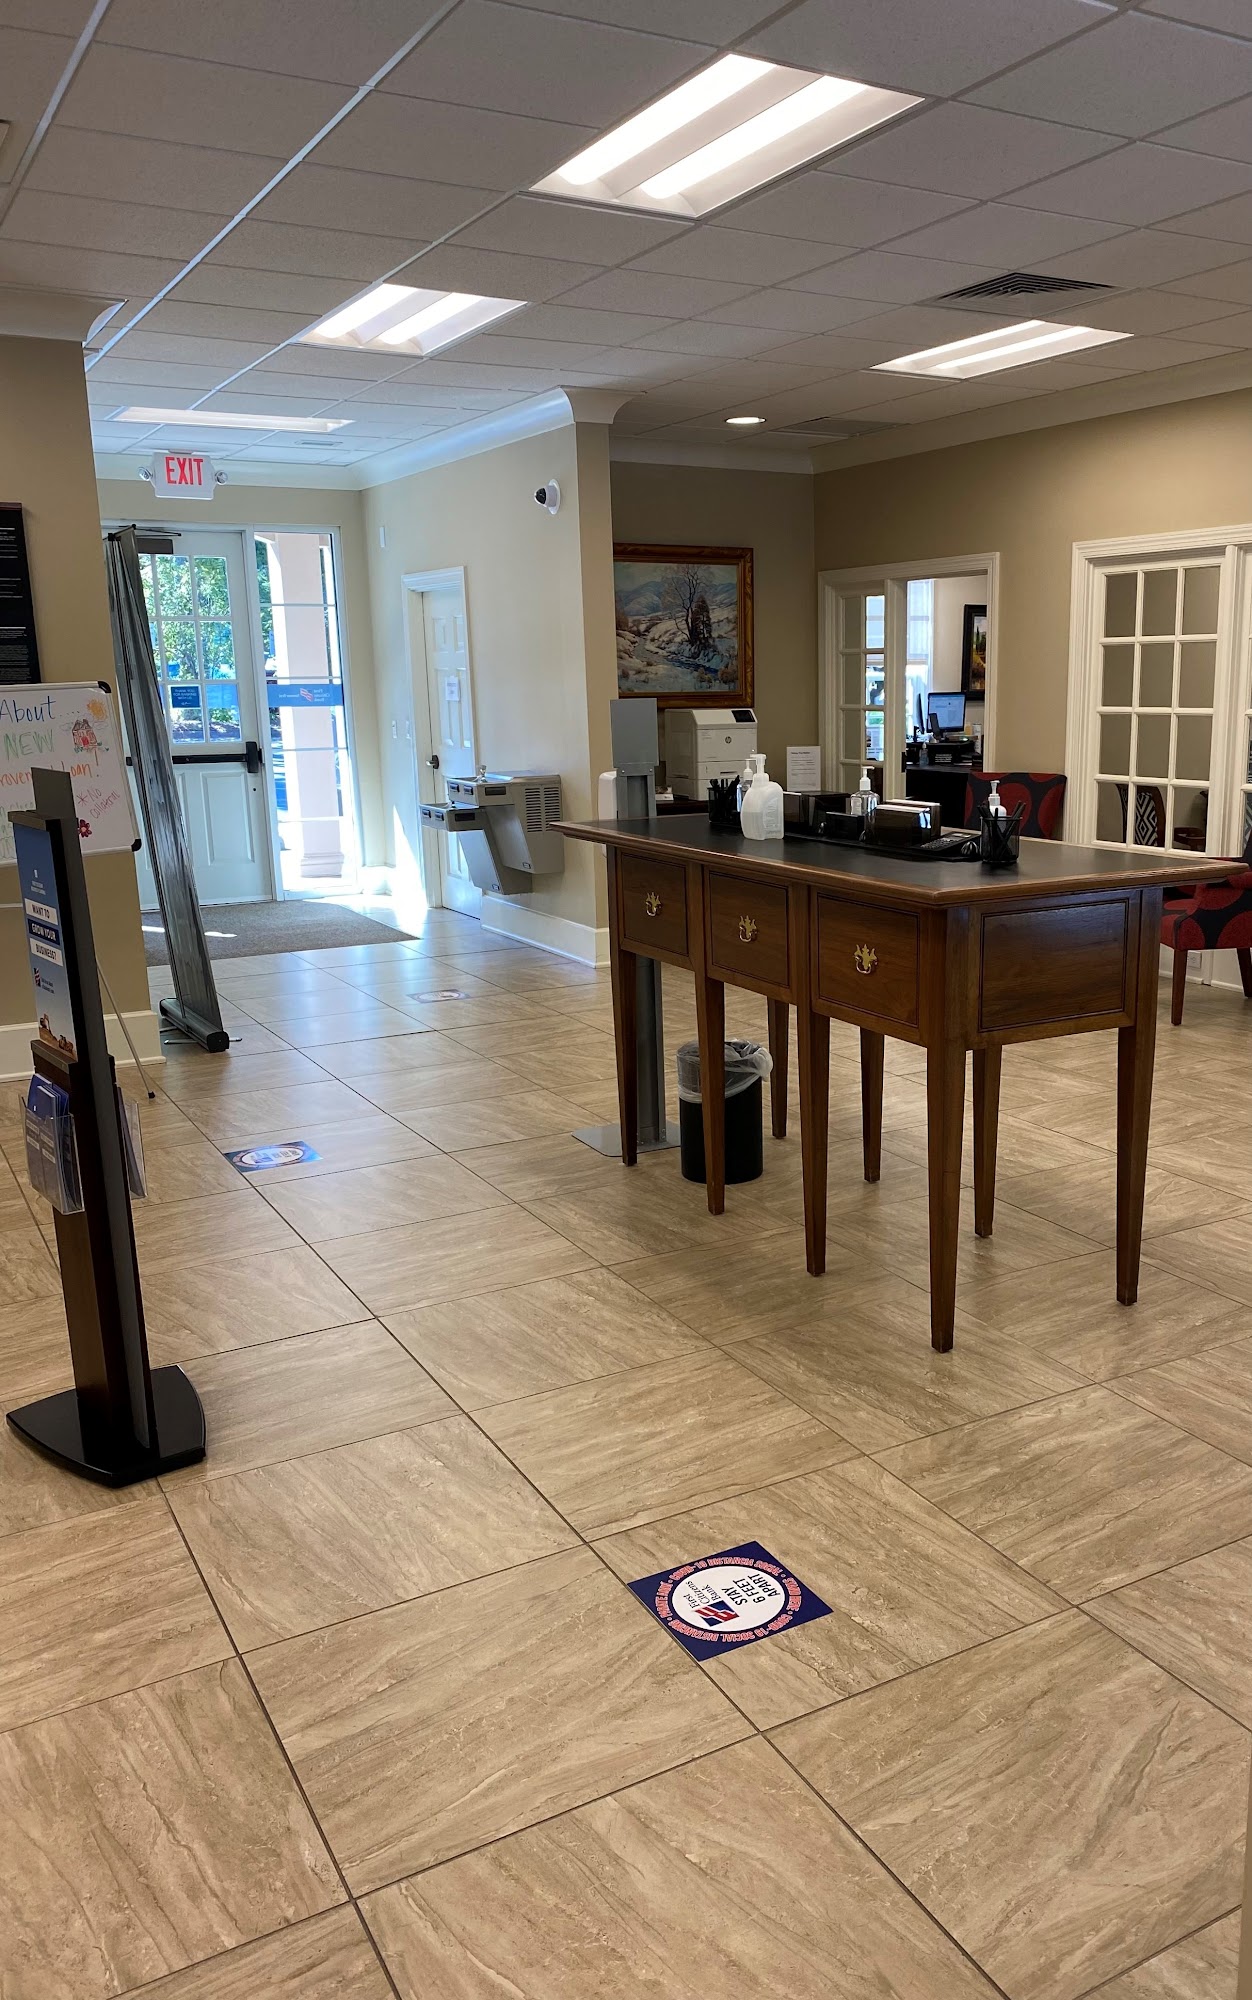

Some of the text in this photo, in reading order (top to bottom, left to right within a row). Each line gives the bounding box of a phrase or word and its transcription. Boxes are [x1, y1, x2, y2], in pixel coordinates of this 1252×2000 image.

[165, 456, 203, 486] EXIT
[4, 729, 54, 761] NEW
[32, 903, 50, 919] WANT TO
[31, 923, 57, 941] GROW YOUR
[35, 943, 57, 961] BUSINESS?
[686, 1581, 710, 1604] Citizens
[702, 1584, 721, 1601] Bank
[732, 1578, 759, 1597] FEET
[747, 1574, 780, 1597] APART
[683, 1594, 700, 1608] First
[721, 1587, 748, 1606] STAY
[754, 1614, 793, 1637] COVID-19
[720, 1631, 755, 1642] SOCIAL
